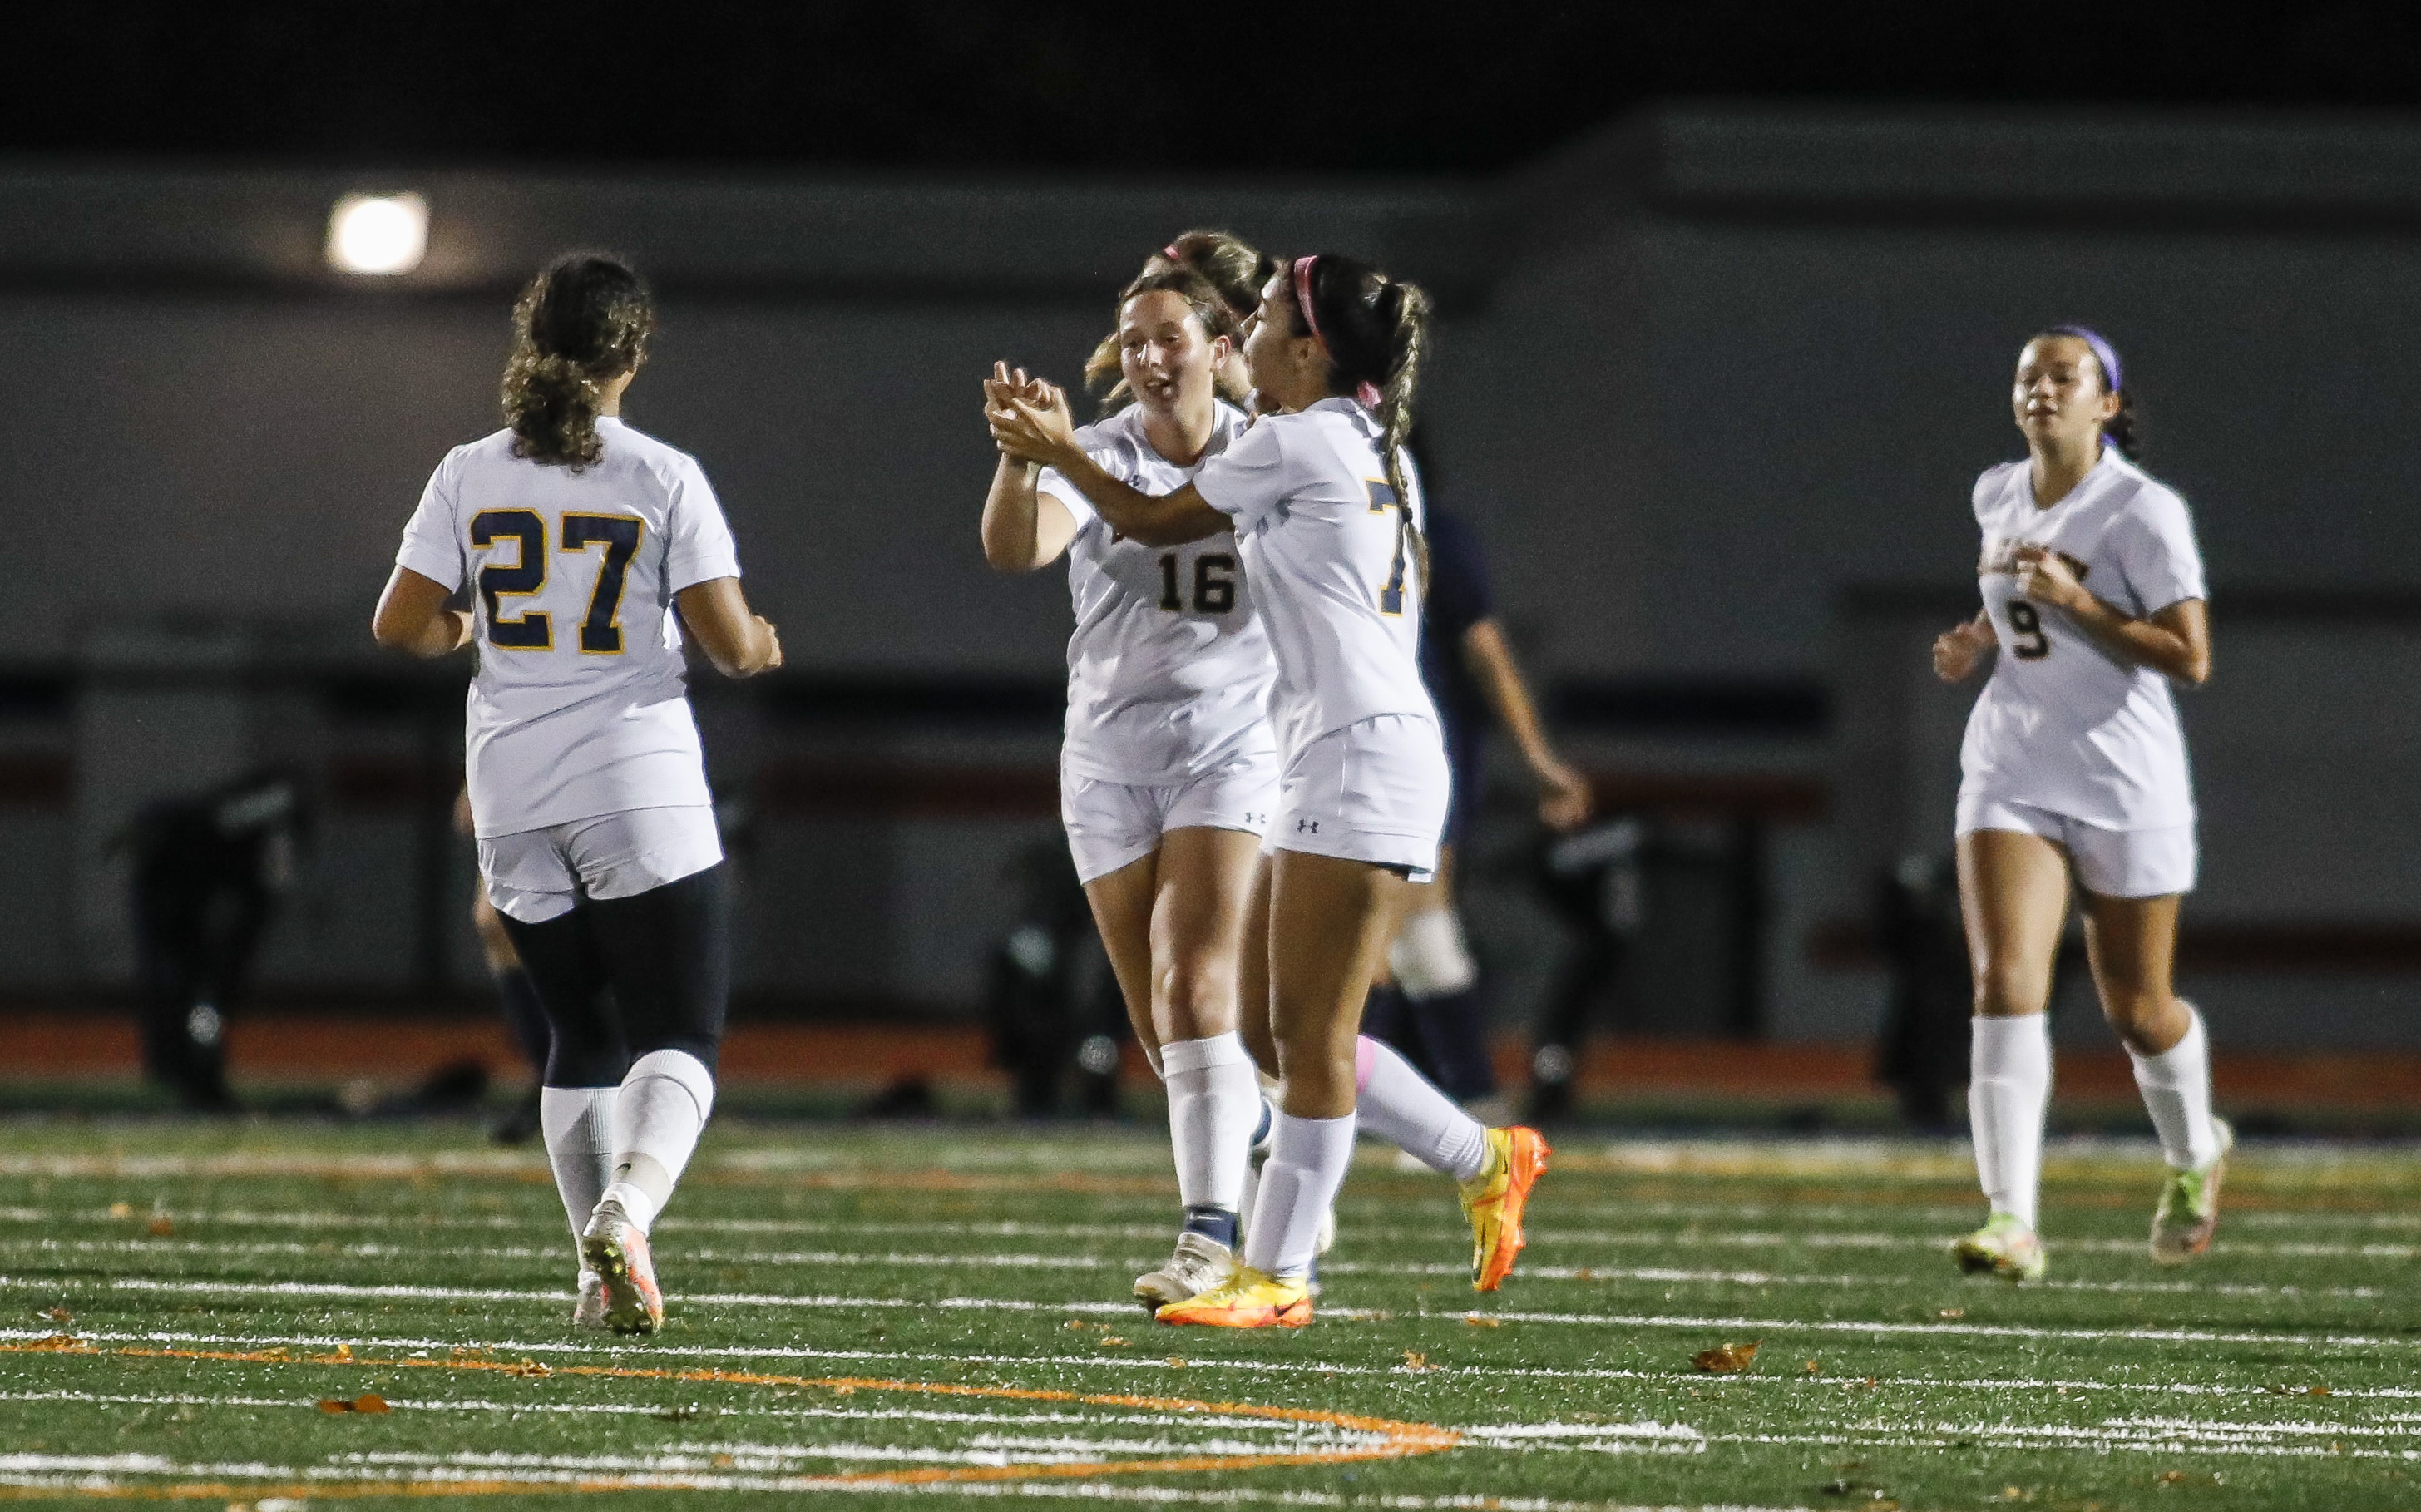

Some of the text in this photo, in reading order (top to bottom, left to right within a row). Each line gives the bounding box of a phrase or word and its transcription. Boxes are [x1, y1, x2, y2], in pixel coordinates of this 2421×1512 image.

[470, 508, 645, 654] 27
[1159, 553, 1236, 614] 16
[1365, 478, 1410, 617] 7
[2008, 600, 2050, 660] 9
